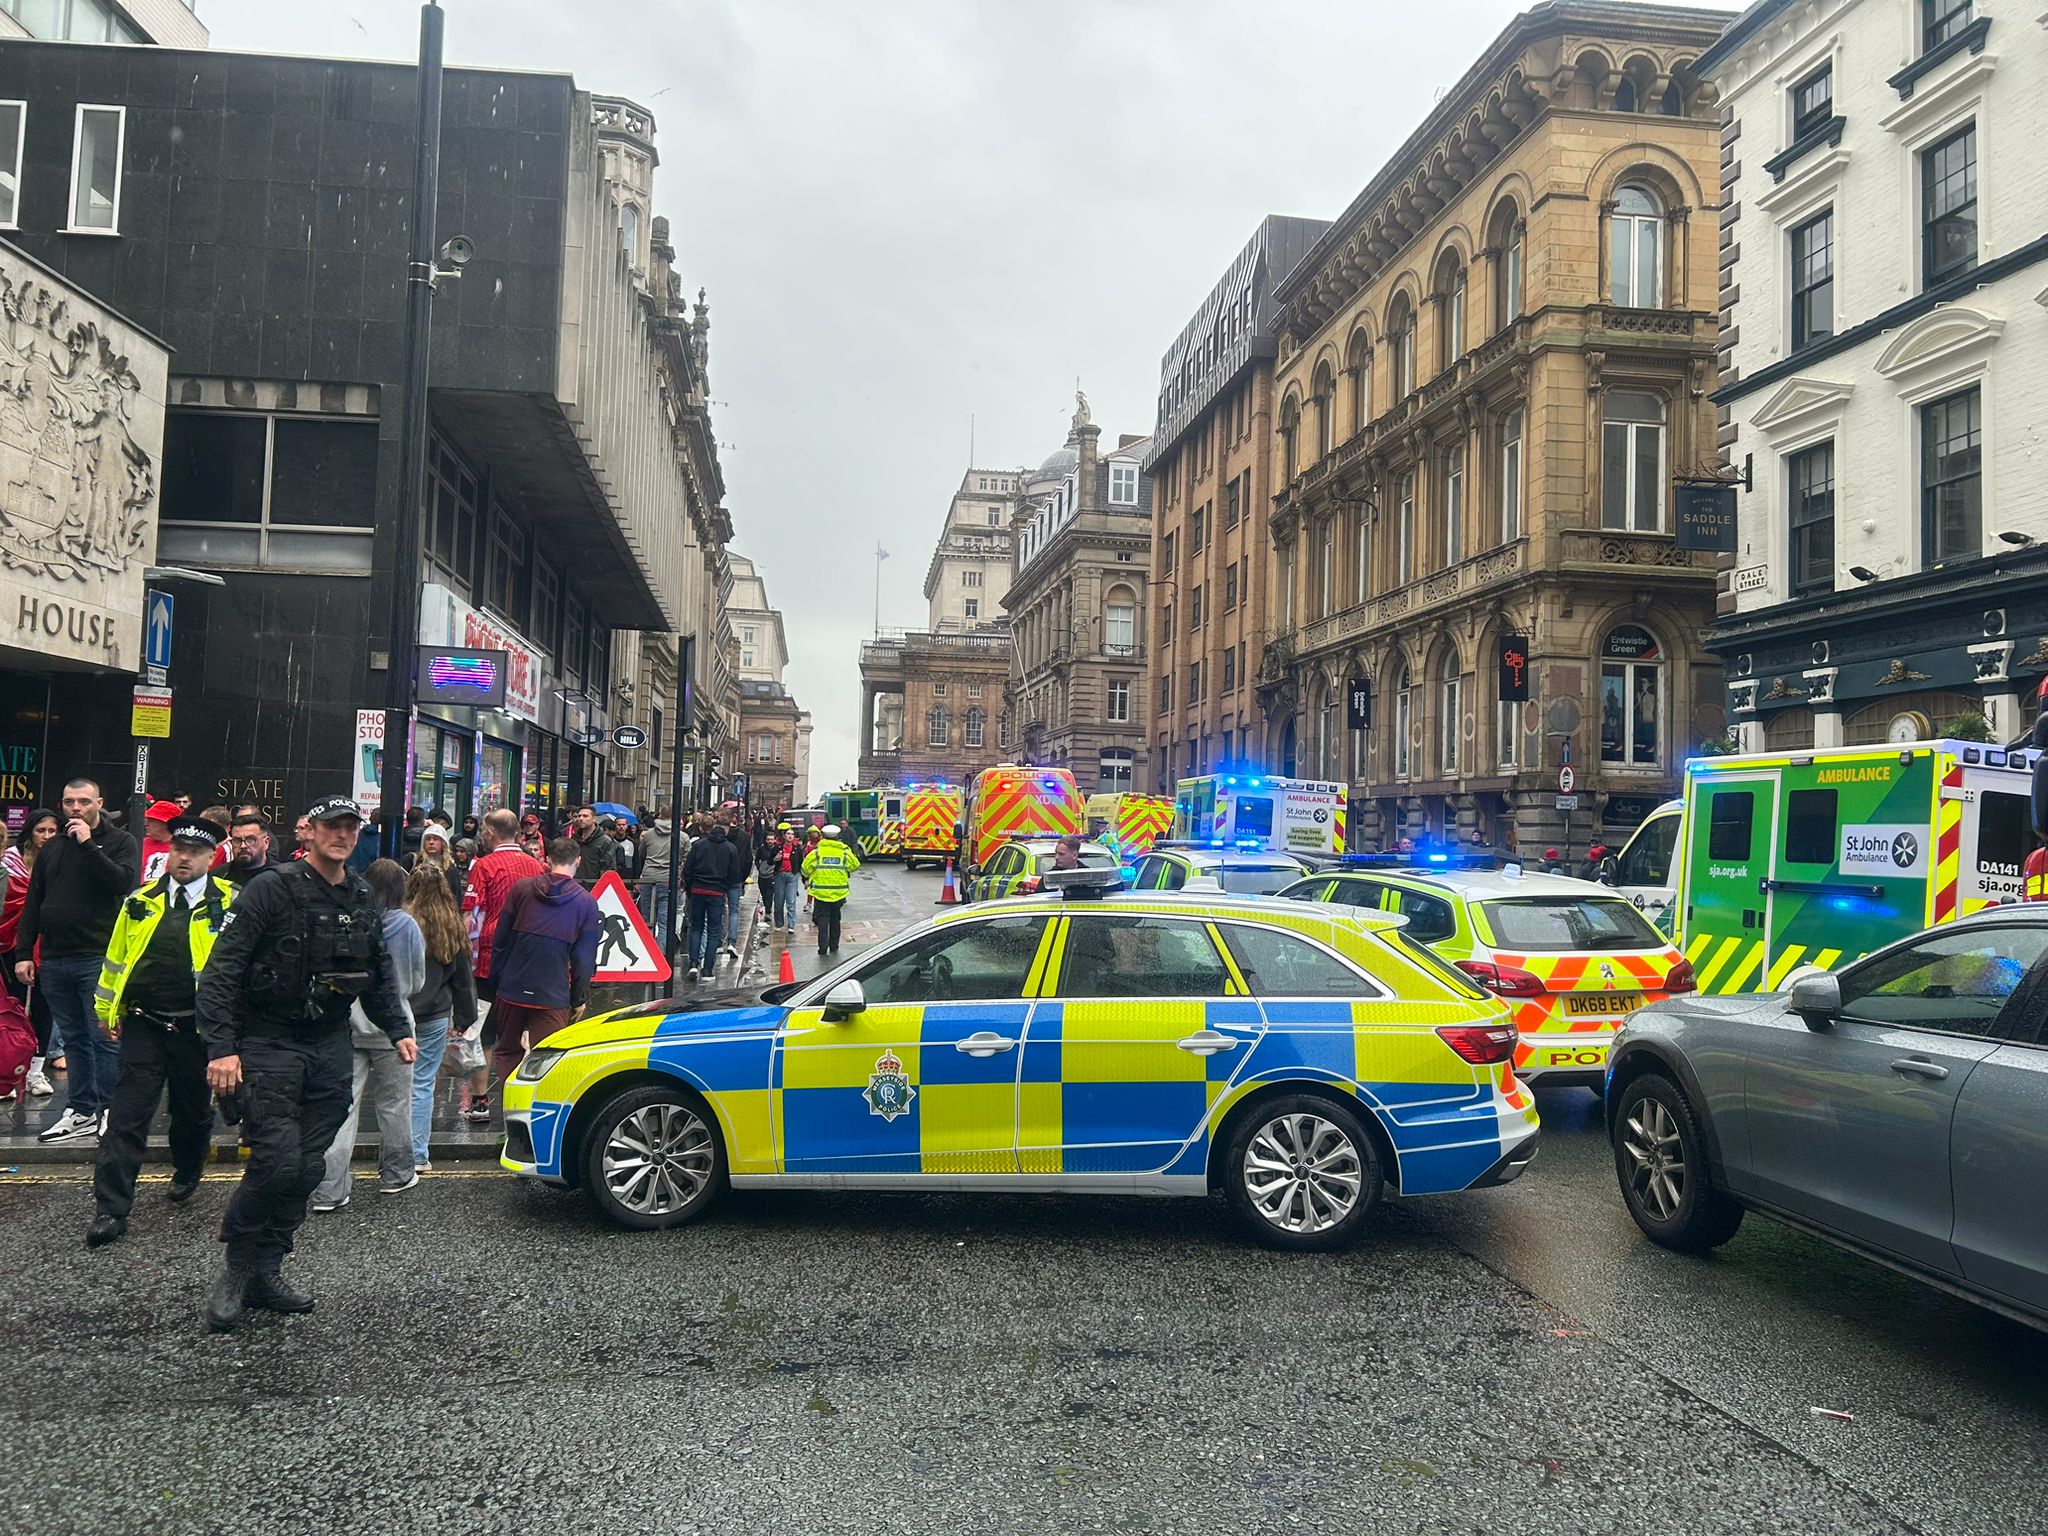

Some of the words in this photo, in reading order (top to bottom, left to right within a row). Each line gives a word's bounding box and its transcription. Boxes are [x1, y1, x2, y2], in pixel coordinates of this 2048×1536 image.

[1683, 513, 1731, 525] SADDLE
[1697, 526, 1718, 536] INN
[1741, 569, 1763, 581] DALE
[1739, 577, 1765, 590] STREET
[18, 594, 116, 650] HOUSE
[1611, 635, 1648, 646] Entwistle
[1611, 644, 1636, 653] Green
[136, 697, 169, 706] WARNING
[359, 712, 385, 725] PHO
[359, 727, 384, 739] STO
[620, 735, 639, 745] HILL
[136, 745, 147, 793] XB1164
[1817, 766, 1891, 784] AMBULANCE
[217, 778, 284, 799] STATE
[1287, 794, 1331, 804] AMBULANCE
[329, 799, 359, 812] POLICE
[1286, 807, 1293, 815] St
[1294, 808, 1312, 817] John
[1291, 828, 1310, 836] Saving
[1298, 834, 1326, 842] supporting
[1846, 835, 1861, 851] St
[1861, 837, 1889, 854] John
[1846, 851, 1888, 863] Ambulance
[1709, 864, 1748, 880] sja.org.uk
[1980, 860, 2019, 876] DA141
[1978, 876, 2024, 897] sja.org
[338, 914, 352, 924] POL
[1570, 996, 1608, 1013] DK68
[1610, 996, 1636, 1012] EKT
[872, 1075, 906, 1092] MERSEYSIDE
[878, 1103, 902, 1112] POLICE
